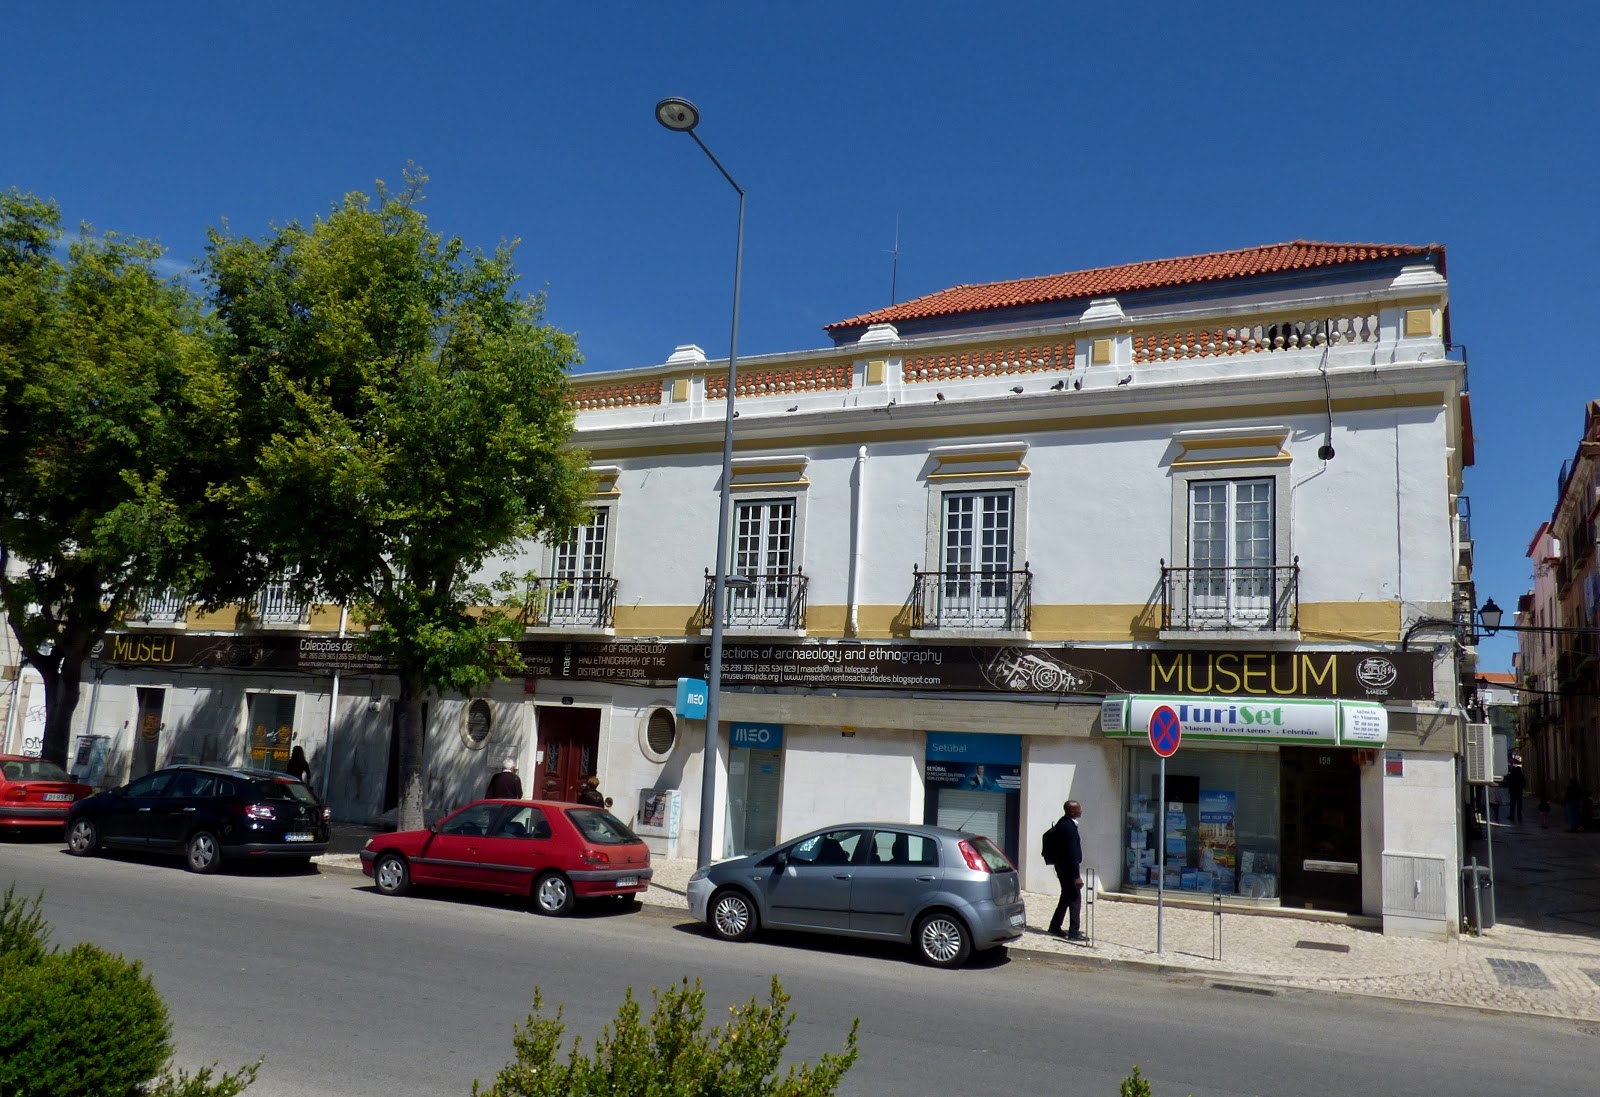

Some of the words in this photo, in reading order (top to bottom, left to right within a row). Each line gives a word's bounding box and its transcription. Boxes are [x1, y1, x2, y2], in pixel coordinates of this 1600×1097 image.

[113, 635, 176, 662] MUSEU
[300, 639, 340, 652] Colecções
[342, 640, 353, 652] de
[580, 643, 608, 653] MUSEUM
[608, 643, 618, 653] OF
[619, 644, 667, 654] ARCHAEOLOGY
[562, 643, 572, 677] maeds
[578, 656, 593, 665] AND
[593, 656, 641, 666] ETHNOGRAPHY
[641, 657, 651, 666] OF
[652, 657, 666, 667] THE
[704, 646, 760, 659] Cections
[761, 647, 774, 659] of
[774, 647, 842, 663] archaeology
[844, 648, 866, 660] and
[869, 647, 942, 665] ethnography
[577, 667, 606, 676] DISTRICT
[606, 668, 616, 677] OF
[720, 664, 730, 672] 65
[730, 664, 742, 672] 239
[742, 664, 755, 672] 365
[758, 664, 771, 673] 265
[771, 664, 783, 673] 534
[800, 665, 879, 675] maeds@mail.telepac.pt
[1151, 653, 1337, 695] MUSEUM
[703, 673, 779, 682] w.museu-maeds.org
[687, 693, 704, 706] MEO
[1175, 704, 1285, 726] TuriSet
[1184, 725, 1212, 733] Viagens
[735, 728, 770, 743] MEO
[932, 743, 967, 753] Setúbal
[1319, 756, 1331, 765] 158
